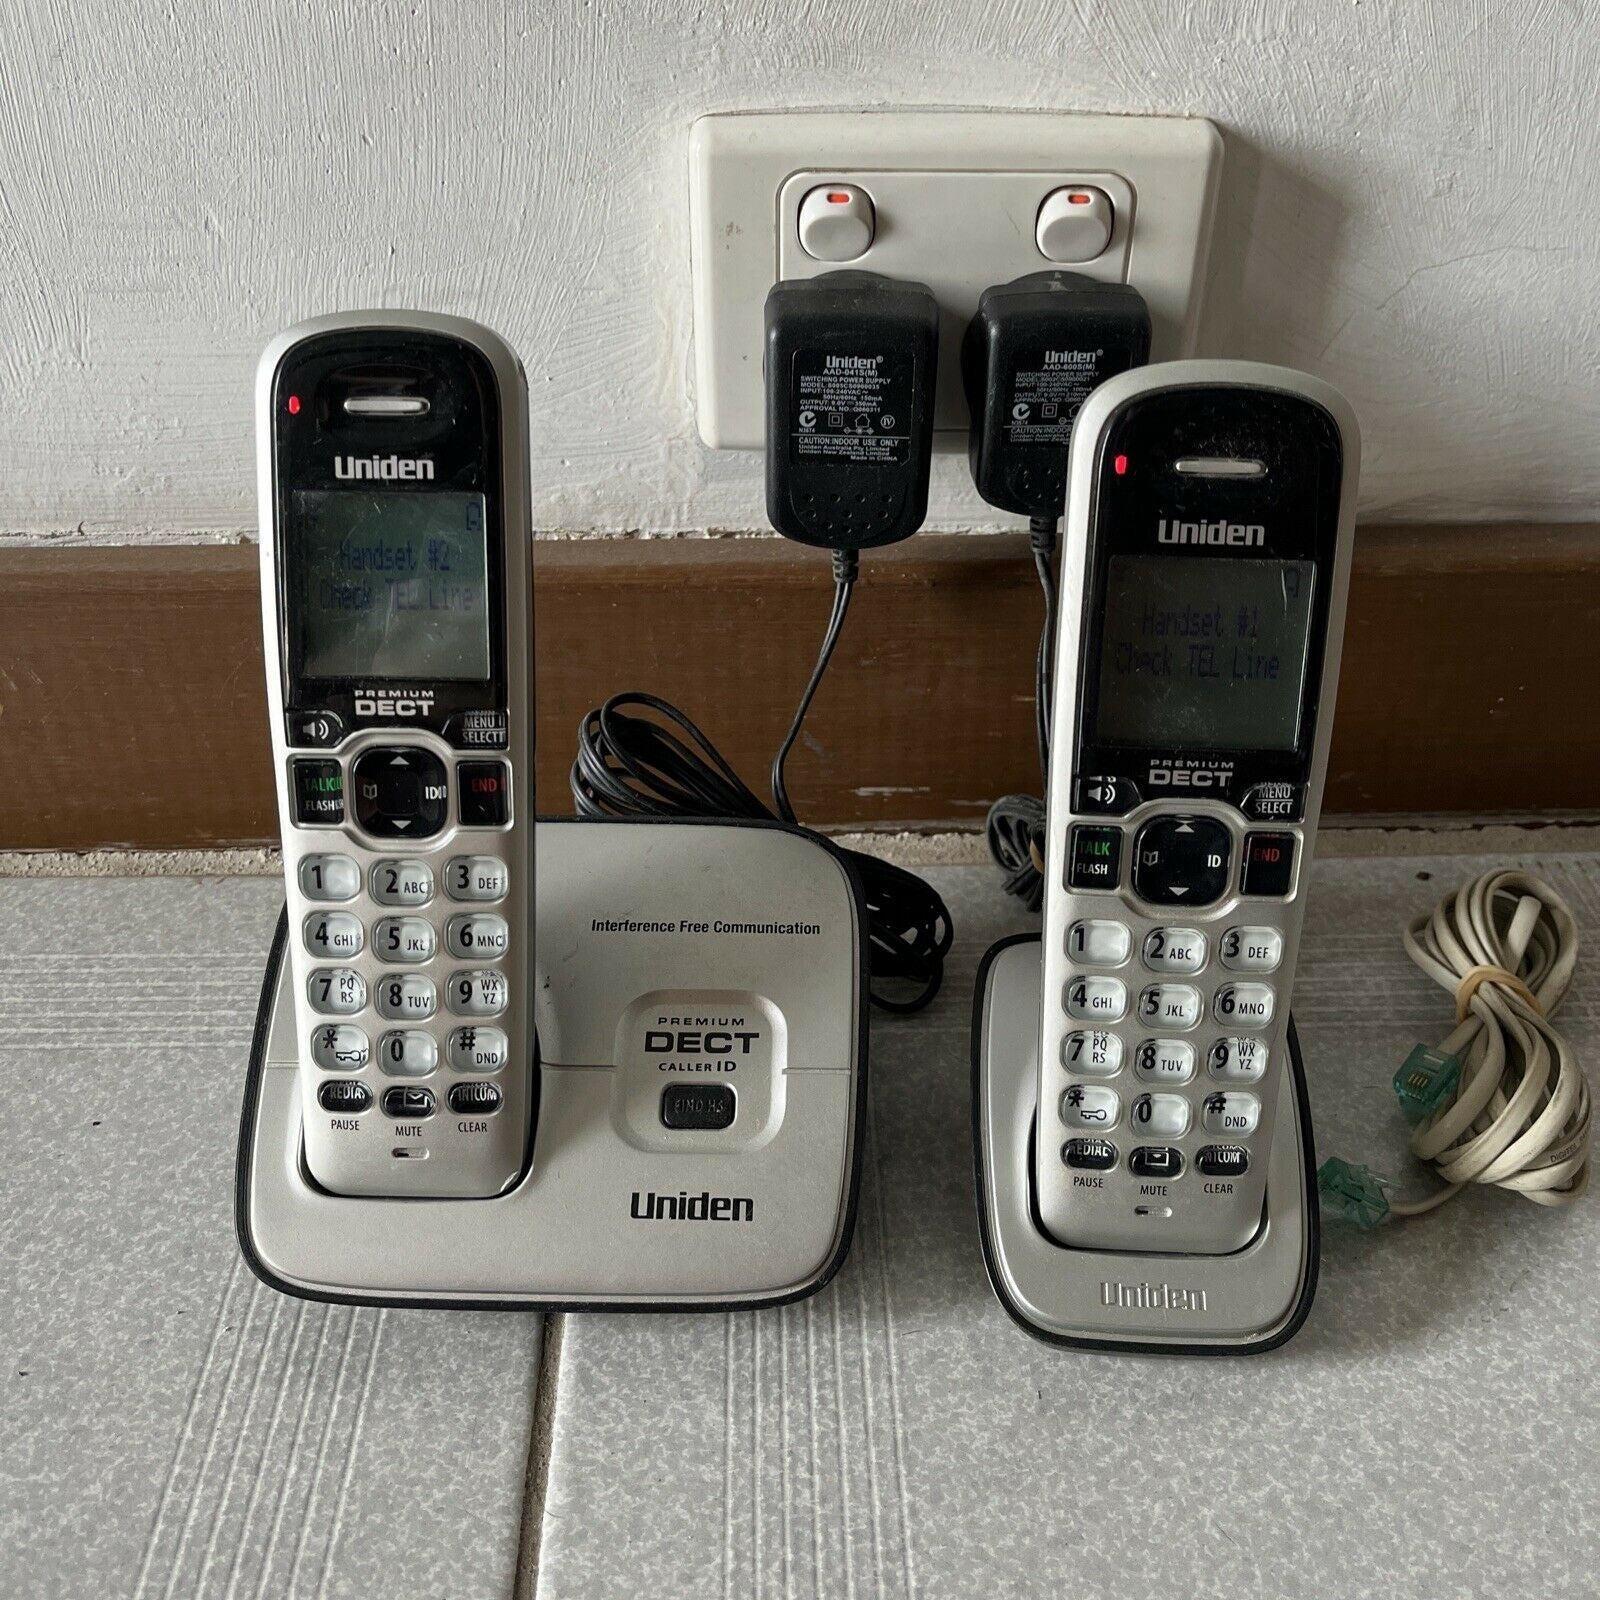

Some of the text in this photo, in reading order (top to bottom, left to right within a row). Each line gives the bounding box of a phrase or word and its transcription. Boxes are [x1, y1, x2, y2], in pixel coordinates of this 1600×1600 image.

[823, 368, 878, 378] AAD-041S(M)
[862, 438, 877, 446] USE
[880, 439, 899, 447] ONLY
[334, 455, 434, 480] Uniden
[1157, 519, 1265, 546] Uniden
[354, 690, 434, 698] PREMIUM
[354, 700, 434, 716] DECT
[1150, 759, 1234, 769] PREMIUM
[472, 778, 498, 792] END
[1149, 769, 1233, 787] DECT
[1258, 786, 1291, 800] MENU
[1255, 801, 1292, 814] SELECT
[1079, 840, 1110, 856] TALK
[1253, 848, 1280, 862] END
[1076, 863, 1108, 875] FLASH
[1208, 854, 1222, 868] ID
[311, 864, 322, 890] 1
[386, 868, 426, 894] 2 ABC
[457, 865, 499, 890] 3 DEF
[315, 922, 354, 946] 4 GHI
[460, 922, 474, 947] 6
[592, 919, 820, 935] Interference Free Communication
[388, 926, 400, 950] 5
[1074, 928, 1085, 952] 1
[1150, 934, 1192, 960] 2 ABC
[1225, 934, 1269, 958] 3 DEF
[319, 978, 354, 1002] 7 PQ
[340, 992, 354, 1004] RS
[389, 982, 430, 1008] 8 TUV
[460, 979, 498, 1004] 9 WX
[483, 993, 496, 1005] YZ
[1072, 984, 1112, 1009] 4 GHI
[1146, 991, 1184, 1017] 5 JKL
[1220, 990, 1264, 1015] 6 MNO
[658, 1016, 744, 1026] PREMIUM
[390, 1038, 404, 1062] 0
[460, 1028, 498, 1064] # DND
[644, 1031, 760, 1054] DECT
[1070, 1038, 1108, 1062] 7 PQ
[1092, 1052, 1106, 1064] RS
[1141, 1046, 1183, 1072] 8 TUV
[1214, 1044, 1256, 1069] 9 WX
[1238, 1058, 1252, 1070] YZ
[658, 1060, 737, 1072] CALLER ID
[1138, 1100, 1152, 1123] 0
[331, 1120, 360, 1130] PAUSE
[458, 1122, 488, 1133] CLEAR
[1224, 1116, 1247, 1128] DND
[395, 1126, 422, 1137] MUTE
[1073, 1176, 1104, 1188] PAUSE
[1140, 1184, 1168, 1196] MUTE
[1204, 1183, 1233, 1194] CLEAR
[630, 1191, 754, 1222] Uniden
[1100, 1282, 1207, 1311] Uniden
